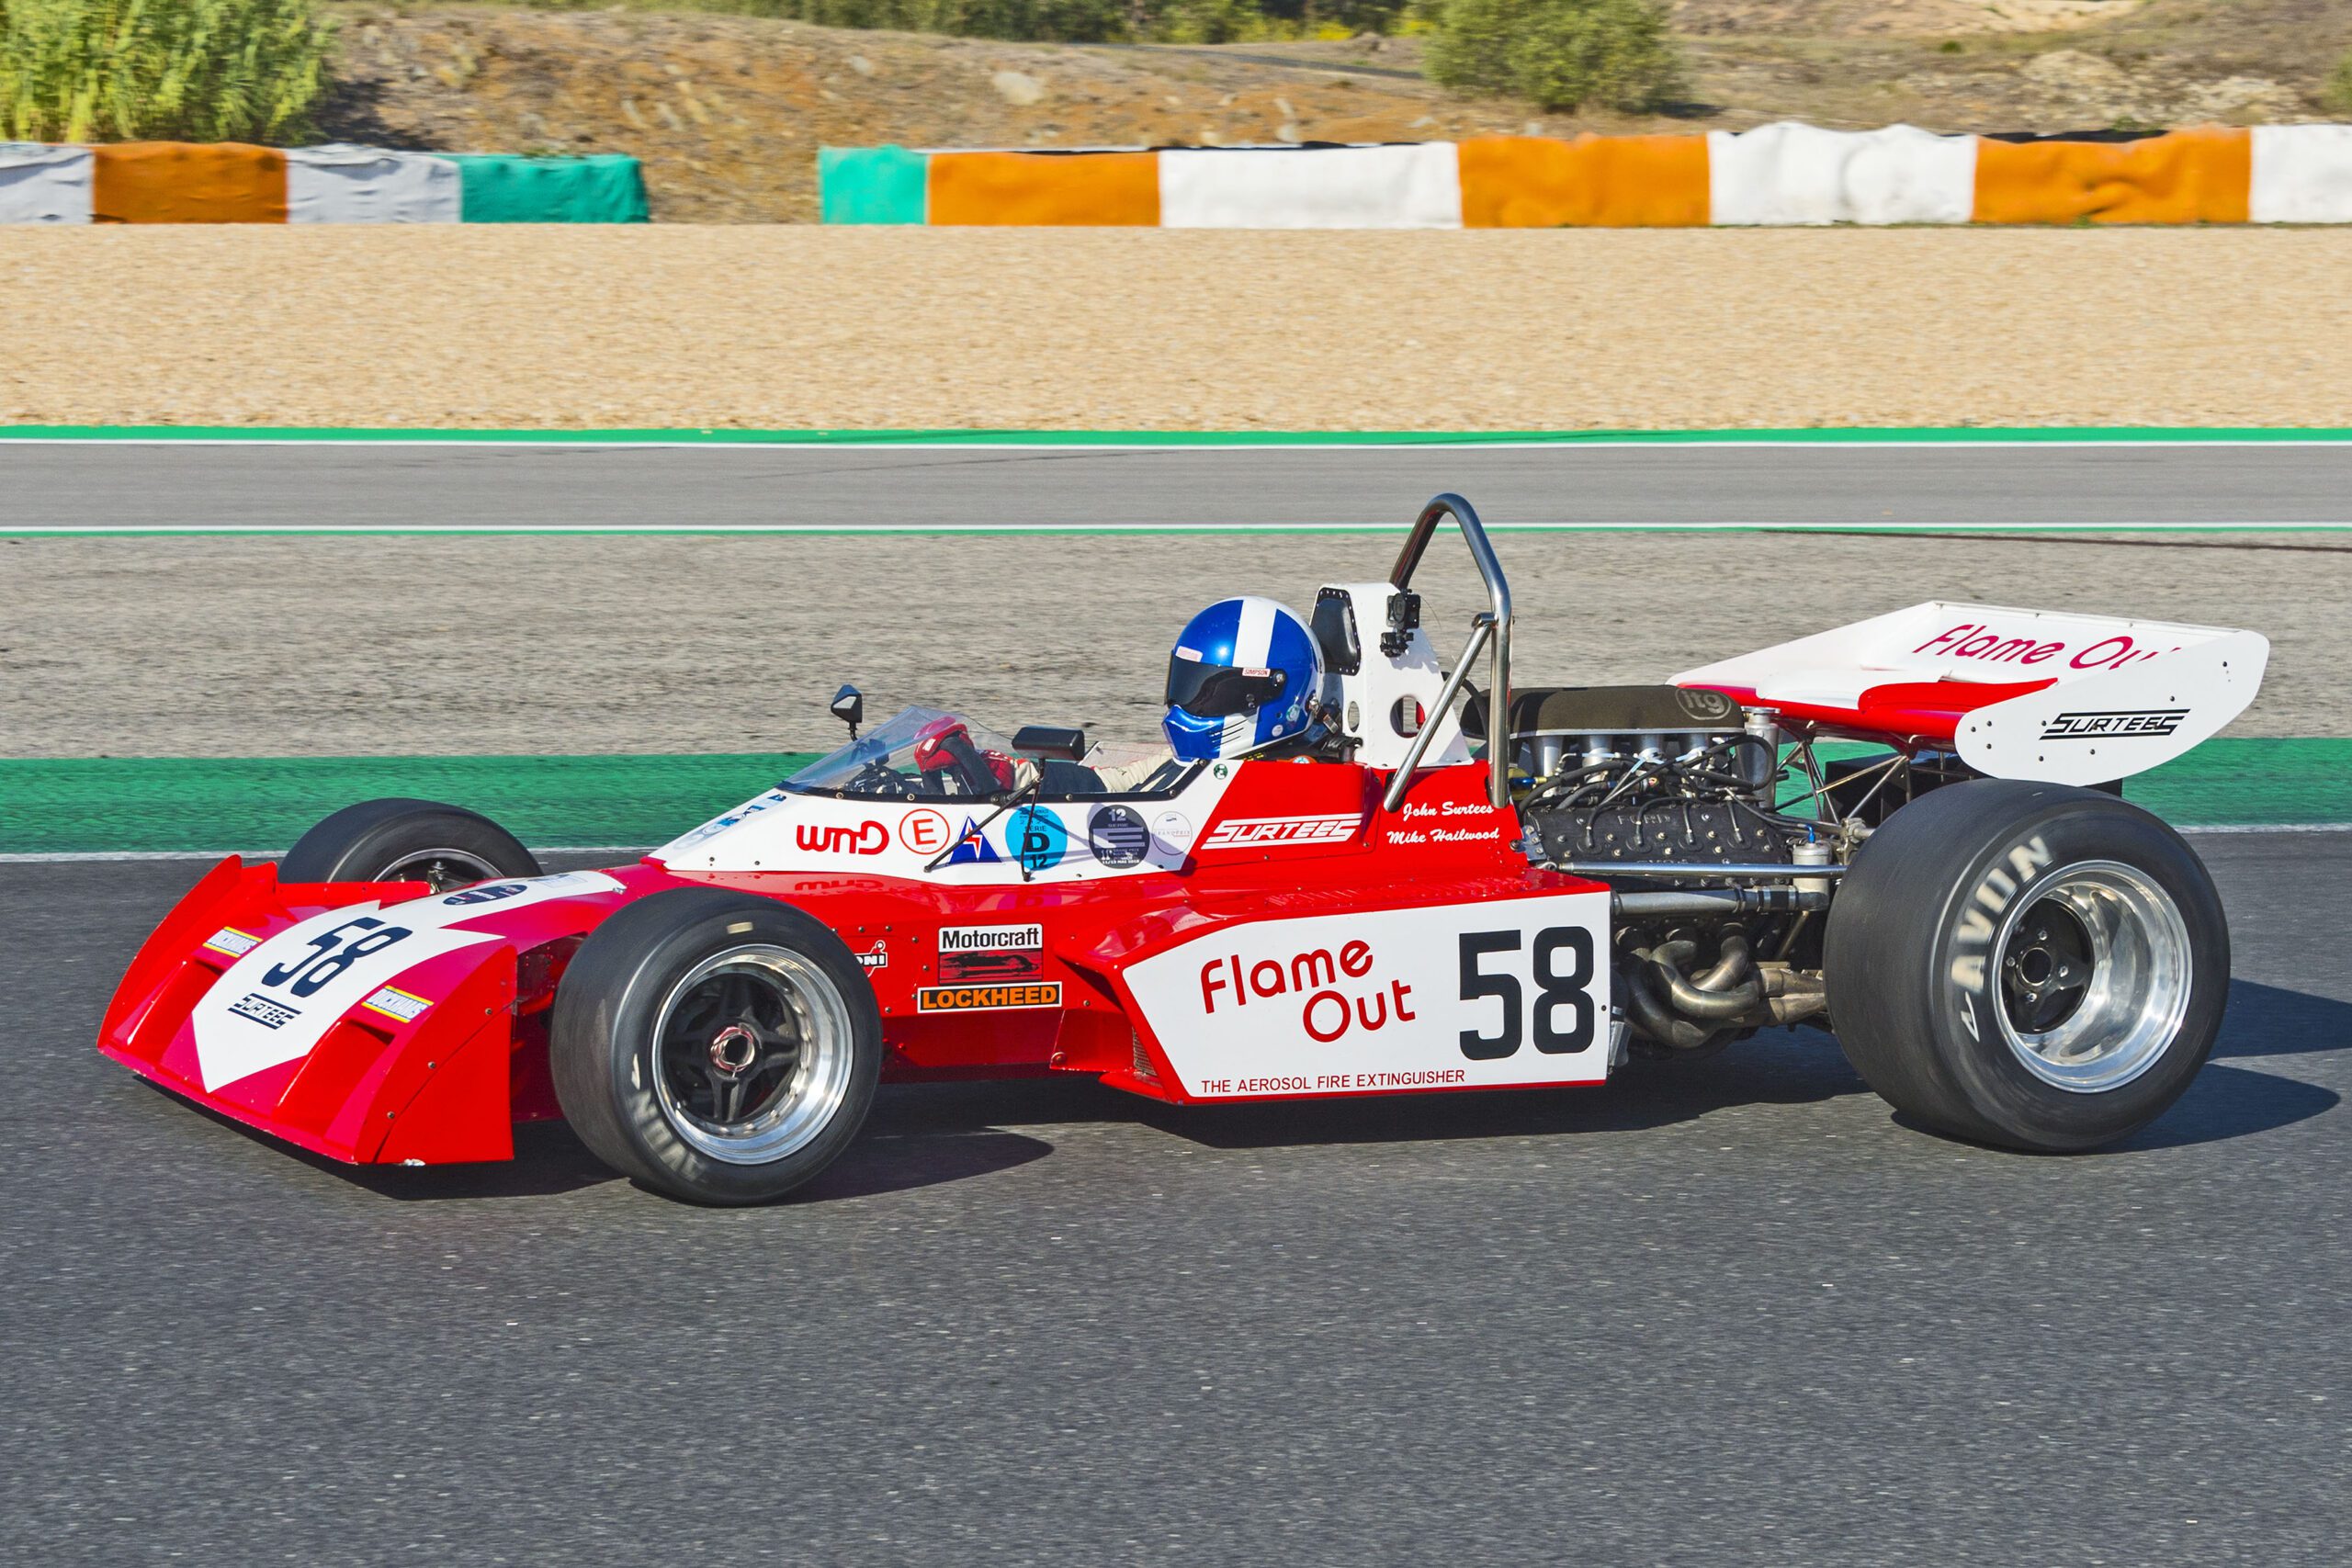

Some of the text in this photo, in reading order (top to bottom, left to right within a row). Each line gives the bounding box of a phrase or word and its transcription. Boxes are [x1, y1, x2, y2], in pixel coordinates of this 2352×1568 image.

[1912, 625, 2182, 671] Flame Ou
[1680, 691, 1724, 714] itg
[2040, 709, 2190, 739] SURTEES
[1108, 808, 1126, 821] 12
[1403, 801, 1494, 821] John Surtees
[912, 818, 937, 845] E
[1023, 832, 1050, 852] D
[1201, 813, 1363, 850] SURTEES
[1386, 827, 1499, 844] Mike Hailwood
[1030, 854, 1049, 868] 12
[943, 928, 1039, 949] Motorcraft
[262, 917, 413, 998] 58
[1201, 940, 1374, 1014] Flame
[922, 986, 1057, 1010] LOCKHEED
[1459, 926, 1594, 1061] 58
[227, 992, 303, 1031] SURTEES
[1303, 979, 1416, 1043] Out
[1202, 1070, 1465, 1093] THE AEROSOL FIRE EXTINGUISHER
